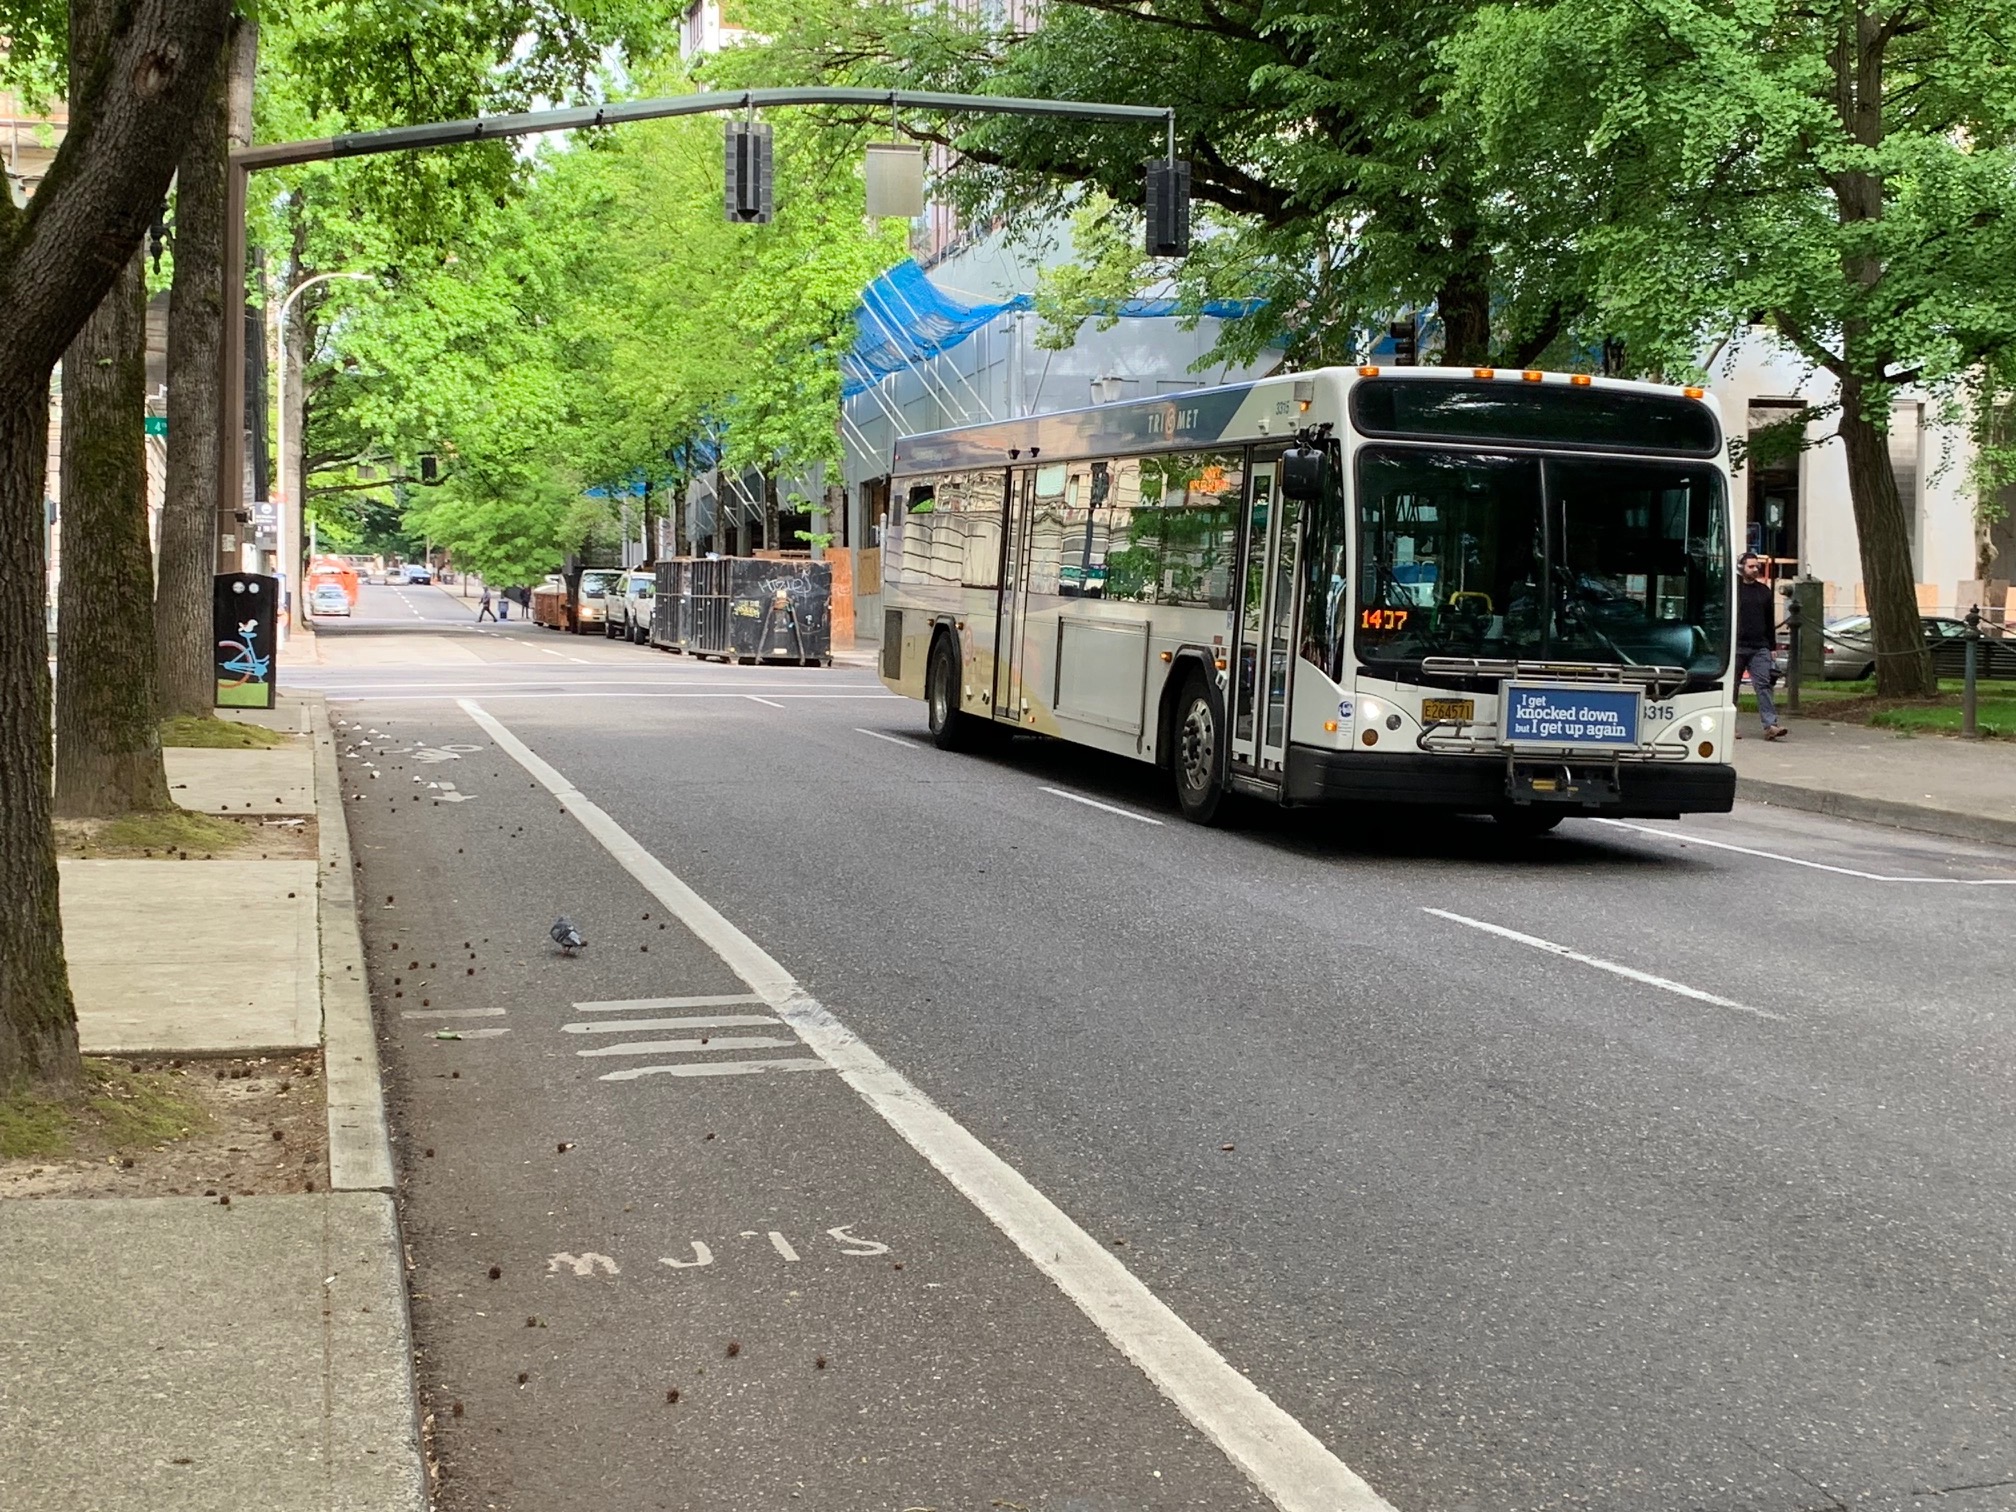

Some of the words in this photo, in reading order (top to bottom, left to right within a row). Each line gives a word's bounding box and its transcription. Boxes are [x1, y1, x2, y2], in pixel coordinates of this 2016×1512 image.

[1148, 410, 1165, 434] TRI
[1177, 408, 1199, 430] MET
[1521, 694, 1527, 706] I
[1528, 695, 1546, 708] get
[1425, 704, 1470, 719] E264571
[1516, 705, 1576, 721] knocked
[1579, 707, 1618, 722] down
[1515, 723, 1530, 733] but
[1531, 719, 1538, 733] I
[1539, 721, 1563, 737] get
[1565, 725, 1583, 738] up
[1586, 723, 1626, 739] again
